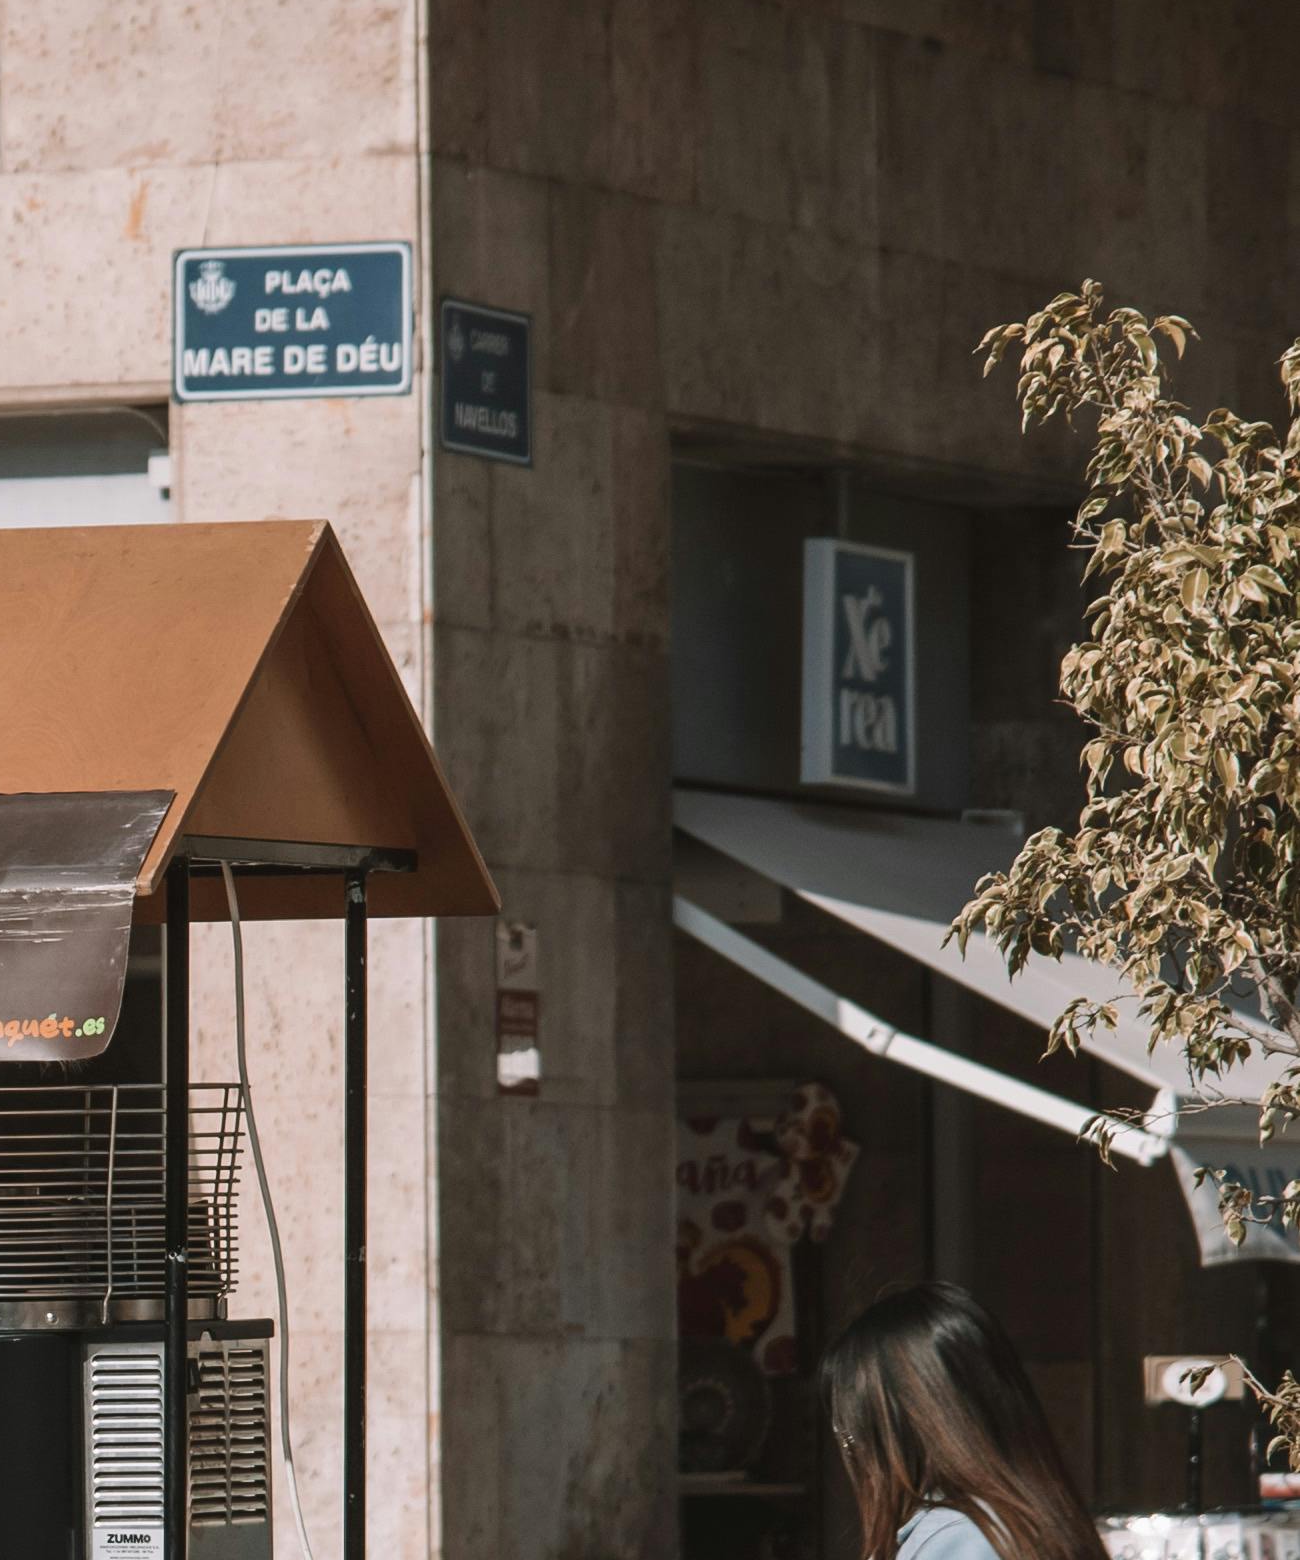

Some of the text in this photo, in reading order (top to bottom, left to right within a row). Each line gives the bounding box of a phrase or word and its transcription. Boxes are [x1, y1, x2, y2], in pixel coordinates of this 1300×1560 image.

[264, 268, 352, 298] PLAÇA
[254, 307, 330, 332] DE LA
[183, 334, 401, 376] MARE DE DÉU
[106, 1533, 151, 1544] ZUMMO
